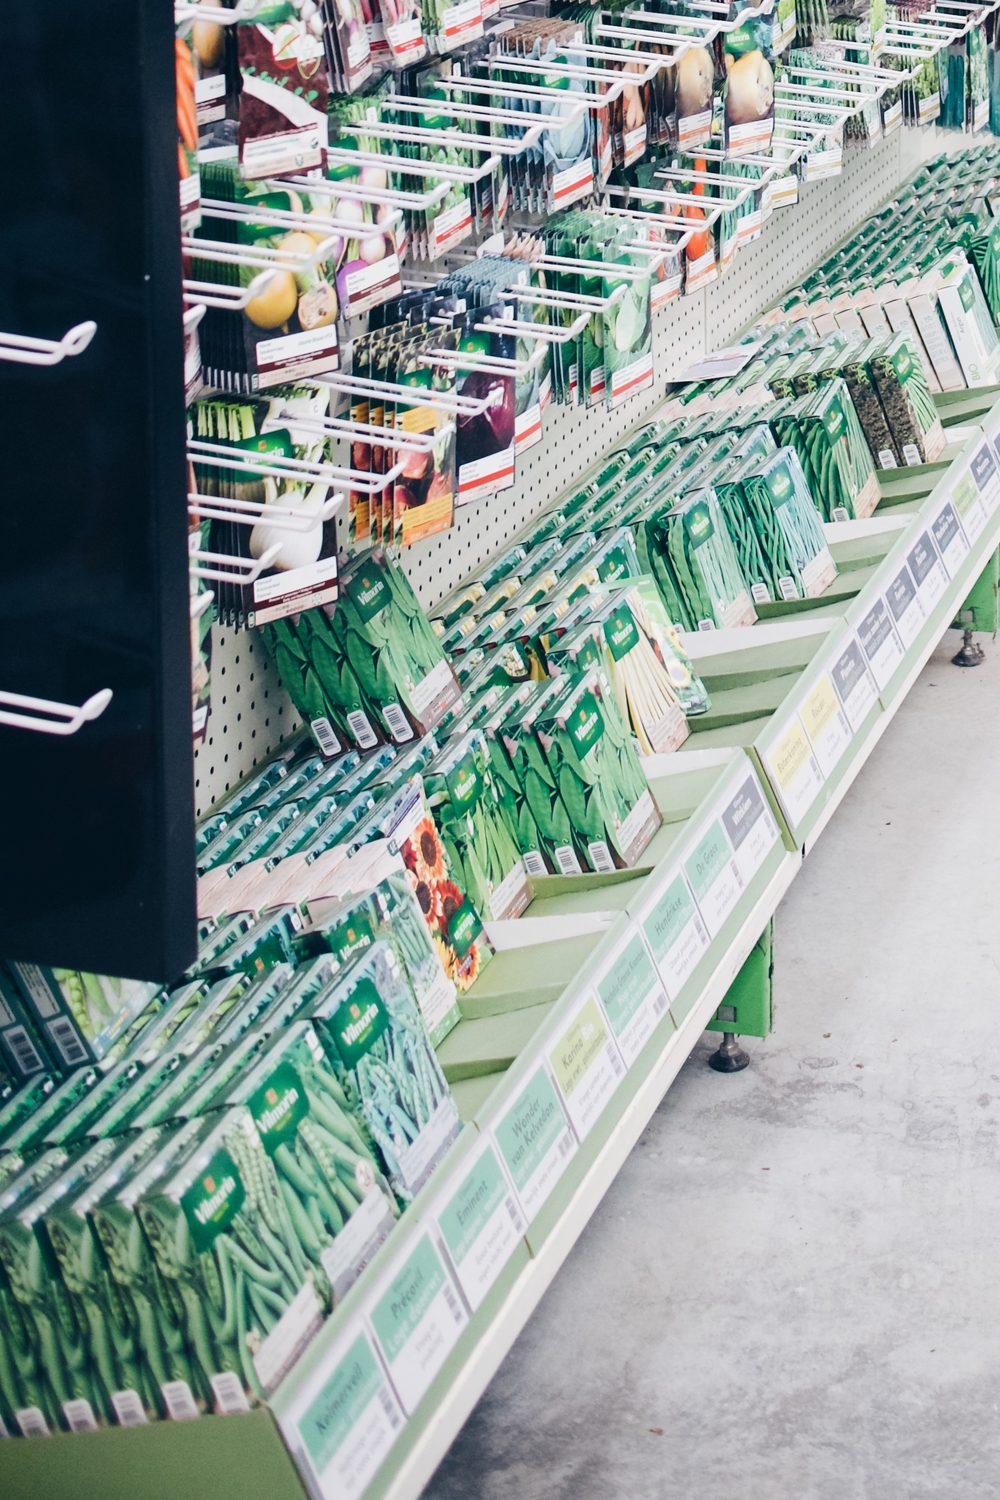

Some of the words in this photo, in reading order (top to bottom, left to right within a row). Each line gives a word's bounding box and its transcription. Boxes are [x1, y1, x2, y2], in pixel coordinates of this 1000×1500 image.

[726, 33, 749, 43] Vilmorin
[968, 363, 981, 381] BIO
[690, 516, 710, 538] Vilmorin
[357, 581, 384, 605] Vilmorin
[612, 623, 633, 648] Vilmorin
[575, 712, 599, 742] Vilmorin
[454, 773, 477, 800] Vilmorin
[695, 858, 706, 877] De
[702, 839, 719, 865] Grace
[653, 893, 683, 937] Hendrikse
[341, 1003, 378, 1046] Vilmorin
[561, 1034, 584, 1071] Karina
[580, 1017, 595, 1042] Bio
[256, 1088, 298, 1134] Vilmorin
[510, 1140, 527, 1168] van
[522, 1096, 555, 1148] Kelvedon
[511, 1093, 541, 1141] Wonder
[195, 1176, 236, 1224] Vilmorin
[455, 1175, 488, 1227] Eminent
[389, 1265, 425, 1322] Précovil
